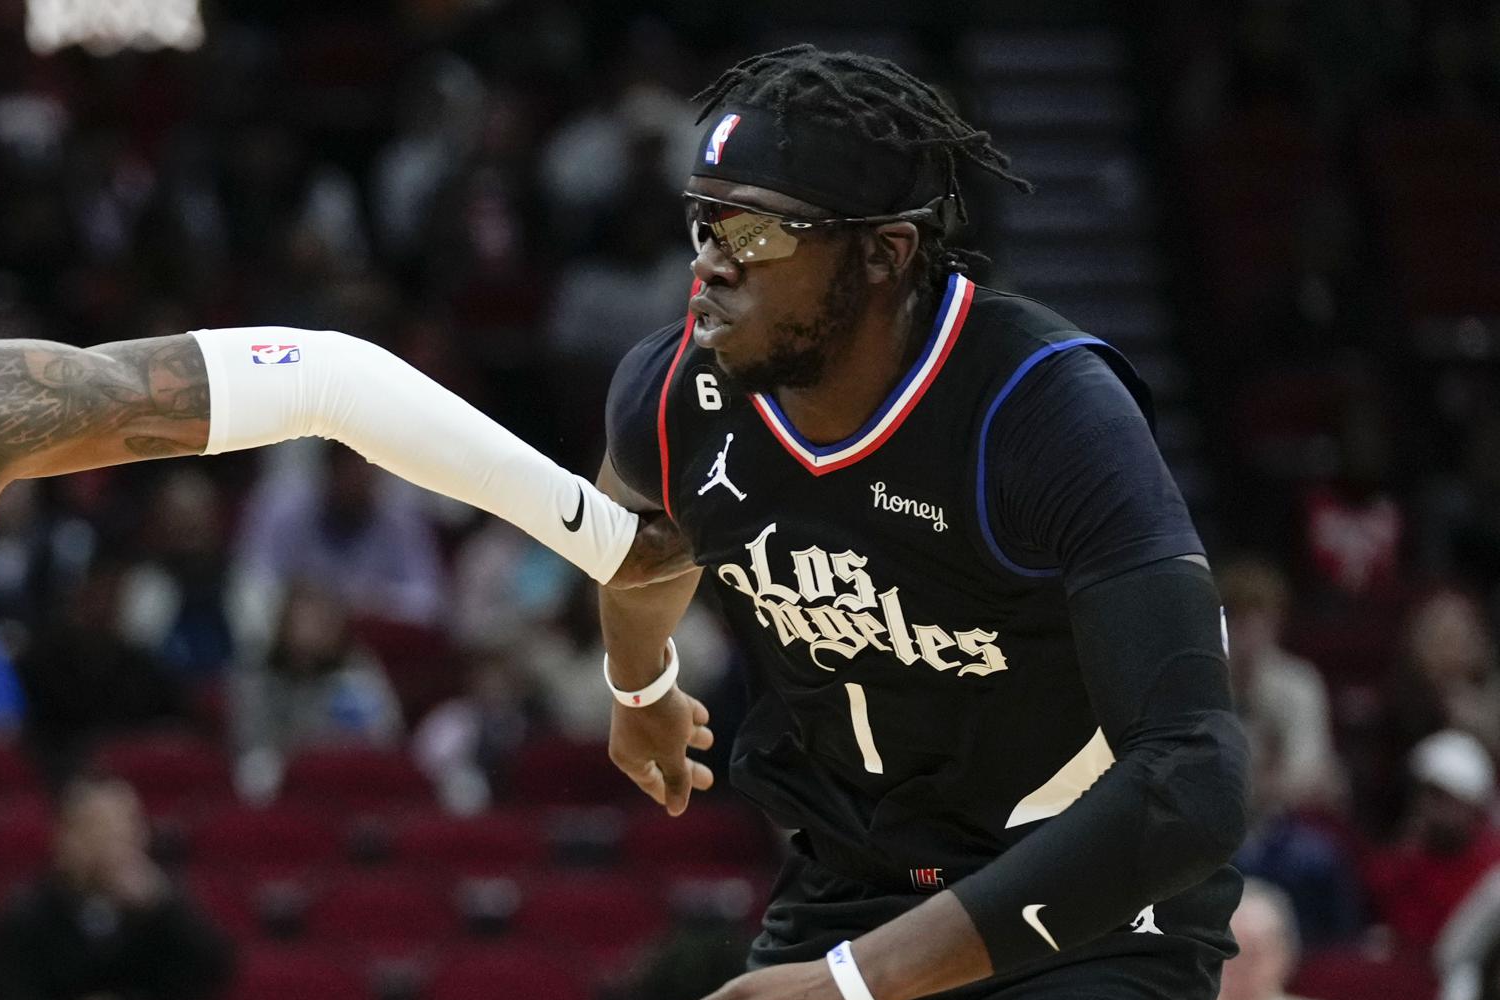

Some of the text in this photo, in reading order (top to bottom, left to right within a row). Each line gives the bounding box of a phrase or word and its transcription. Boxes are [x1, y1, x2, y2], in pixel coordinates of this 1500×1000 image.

[696, 373, 722, 410] 6
[870, 481, 949, 532] honey
[745, 522, 879, 612] Los
[844, 682, 884, 774] 1
